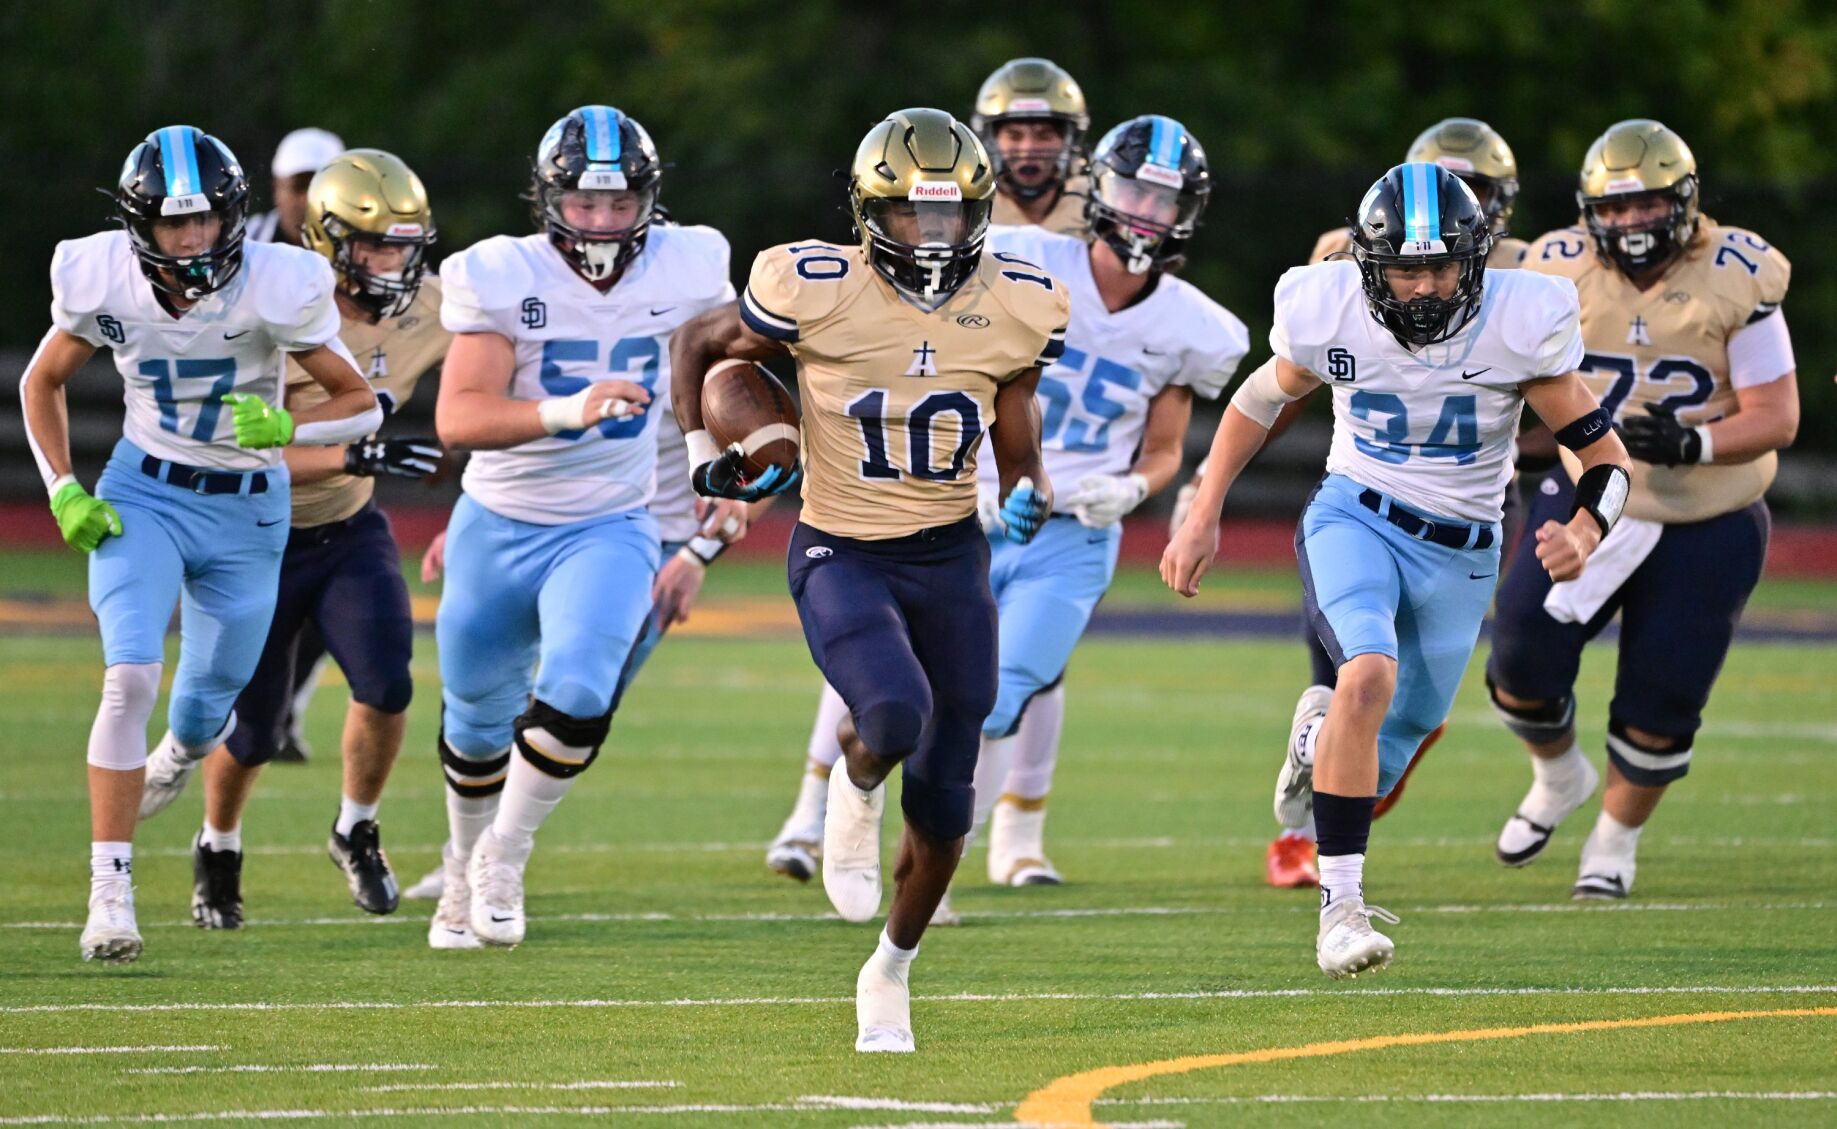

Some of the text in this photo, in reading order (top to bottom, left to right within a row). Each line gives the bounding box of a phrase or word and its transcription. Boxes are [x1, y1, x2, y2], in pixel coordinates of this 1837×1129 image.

[915, 186, 958, 197] Riddell
[1542, 232, 1585, 260] 2
[96, 314, 126, 344] SD
[521, 296, 547, 330] SD
[539, 336, 660, 441] 53
[1327, 348, 1356, 382] SD
[1577, 352, 1726, 428] 72
[138, 357, 238, 443] 17
[844, 388, 985, 483] 10
[1350, 389, 1483, 467] 34
